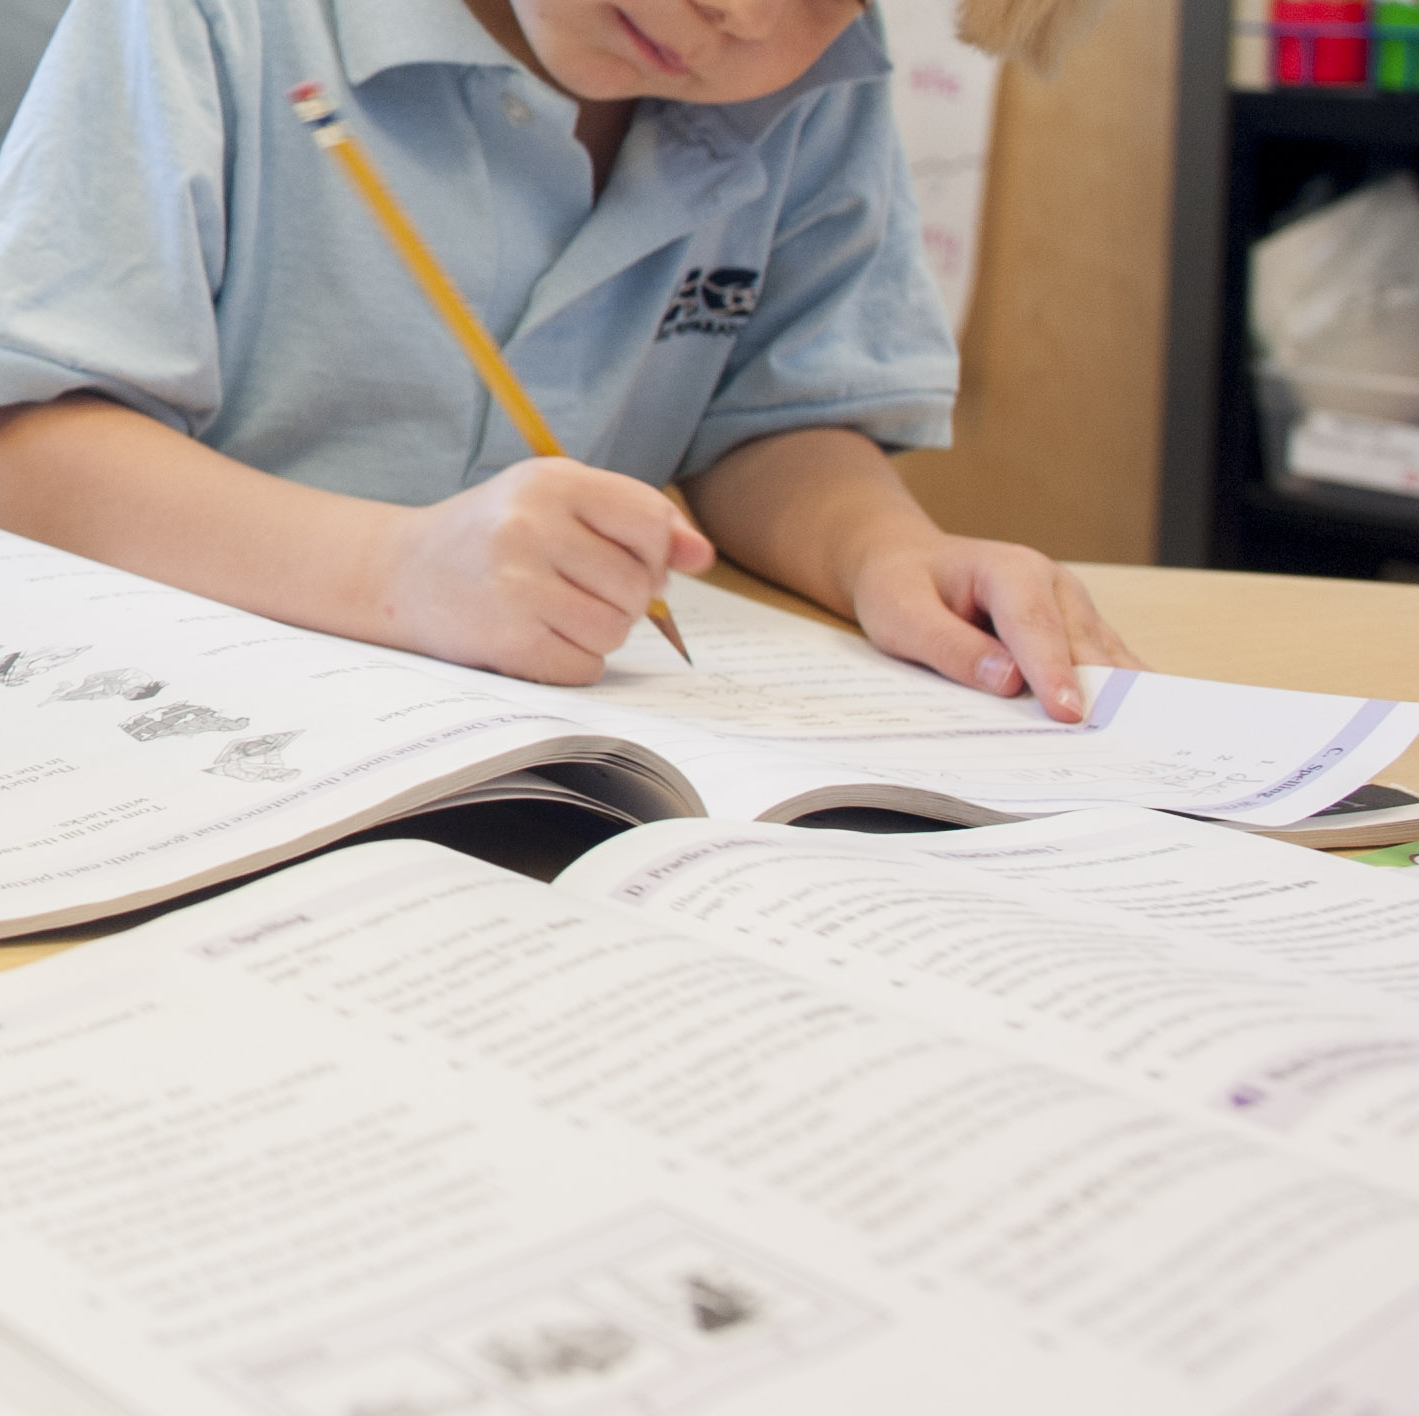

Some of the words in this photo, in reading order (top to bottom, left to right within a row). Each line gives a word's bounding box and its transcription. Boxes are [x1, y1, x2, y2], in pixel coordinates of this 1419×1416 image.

[440, 722, 489, 738] Draw
[393, 743, 427, 757] line
[44, 757, 65, 766] in
[341, 755, 391, 778] under
[12, 763, 45, 775] the
[40, 764, 80, 777] The
[308, 777, 340, 791] the
[108, 797, 150, 813] with
[121, 804, 168, 820] Tom
[230, 791, 308, 824] sentence
[53, 811, 108, 829] tacks.
[86, 819, 120, 833] will
[58, 829, 86, 841] fill
[191, 822, 231, 837] that
[26, 837, 58, 849] the
[147, 834, 190, 850] goes
[103, 851, 146, 867] with
[57, 864, 102, 878] each
